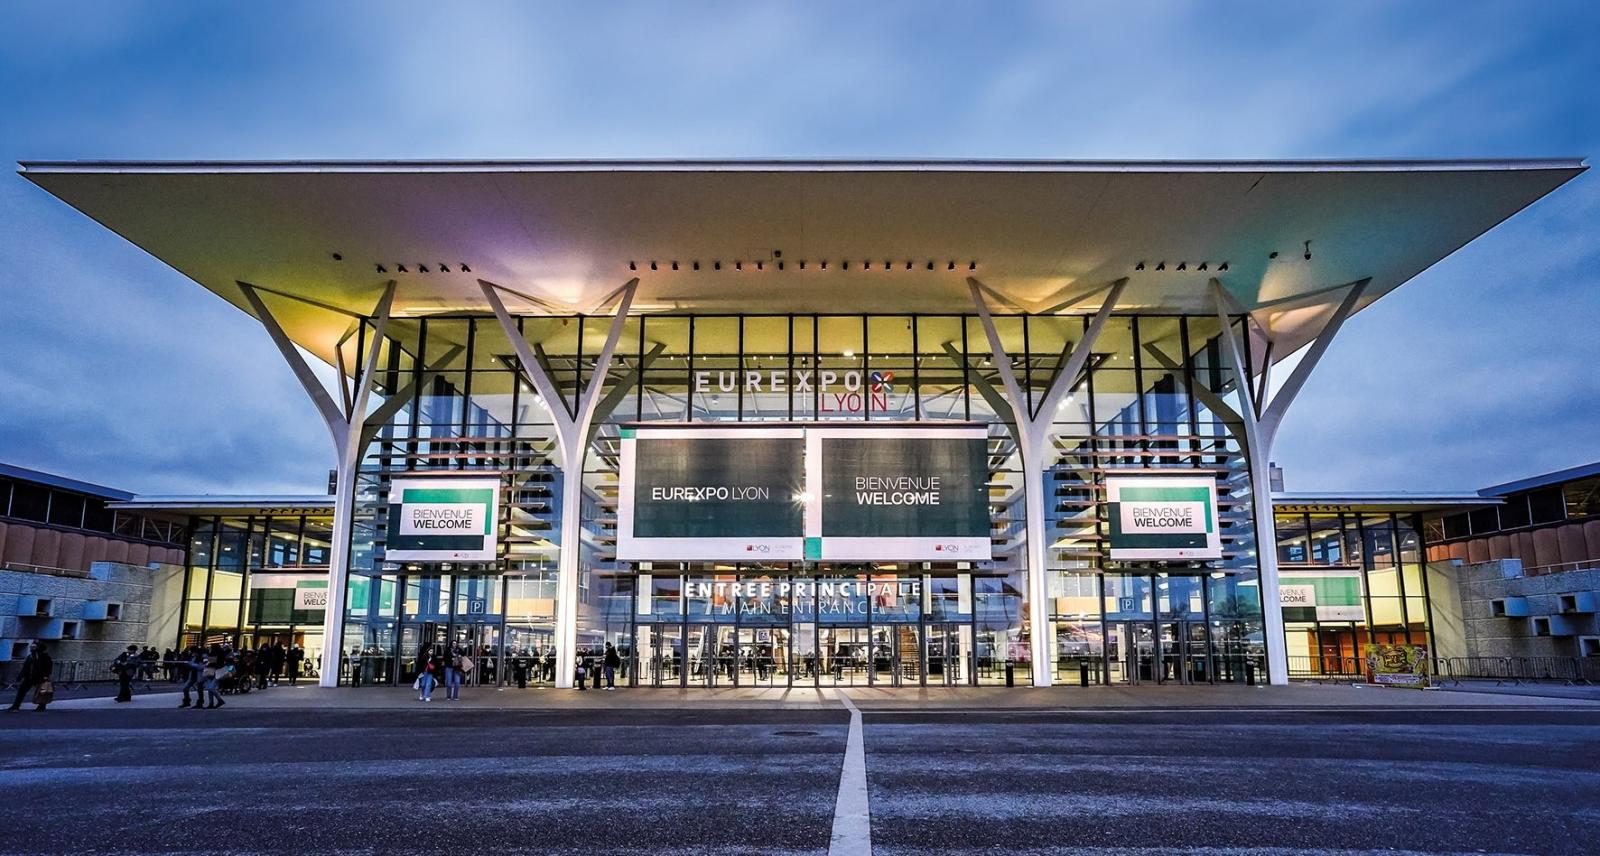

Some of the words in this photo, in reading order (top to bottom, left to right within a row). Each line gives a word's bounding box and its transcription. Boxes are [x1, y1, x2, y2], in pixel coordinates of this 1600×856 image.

[694, 371, 861, 393] EUREXPO
[821, 393, 887, 413] LYON
[855, 476, 940, 490] BIENVENUE
[652, 487, 729, 500] EUREXPO
[731, 486, 769, 500] LYON
[856, 491, 940, 505] WELCOME
[413, 508, 473, 519] BIENVENUE
[1133, 507, 1193, 518] BIENVENUE
[413, 519, 472, 529] WELCOME
[1134, 518, 1192, 528] WELCOME
[303, 591, 328, 599] BIENVE
[685, 582, 771, 598] ENTREE
[780, 582, 921, 598] PRINCIPALE
[1279, 595, 1307, 603] LCOME
[723, 601, 771, 615] MAIN
[781, 600, 880, 615] ENTRANCE
